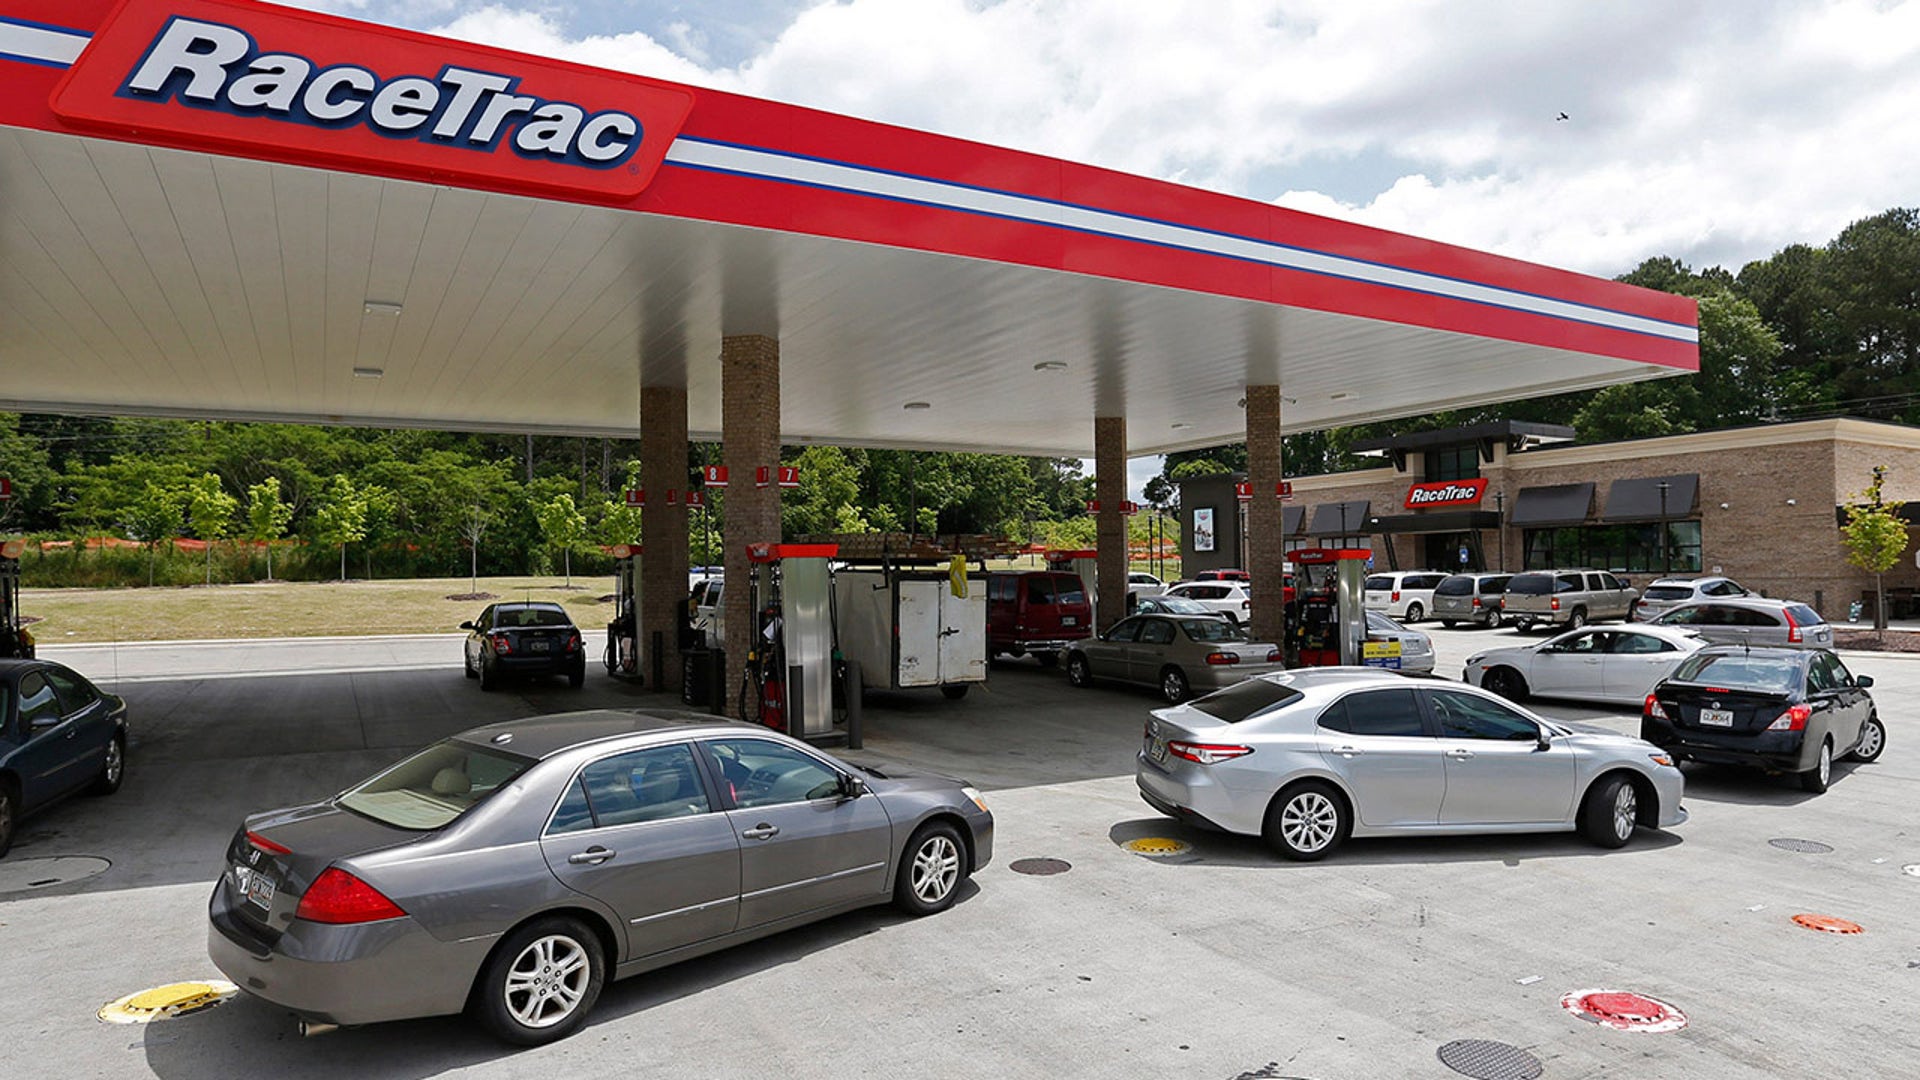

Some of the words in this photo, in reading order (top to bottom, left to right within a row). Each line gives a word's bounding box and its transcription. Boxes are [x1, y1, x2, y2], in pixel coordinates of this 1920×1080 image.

[127, 16, 638, 163] RaceTrac
[709, 467, 717, 481] 8
[786, 468, 793, 481] 7
[692, 491, 699, 503] 5
[1410, 485, 1476, 503] RaceTrac
